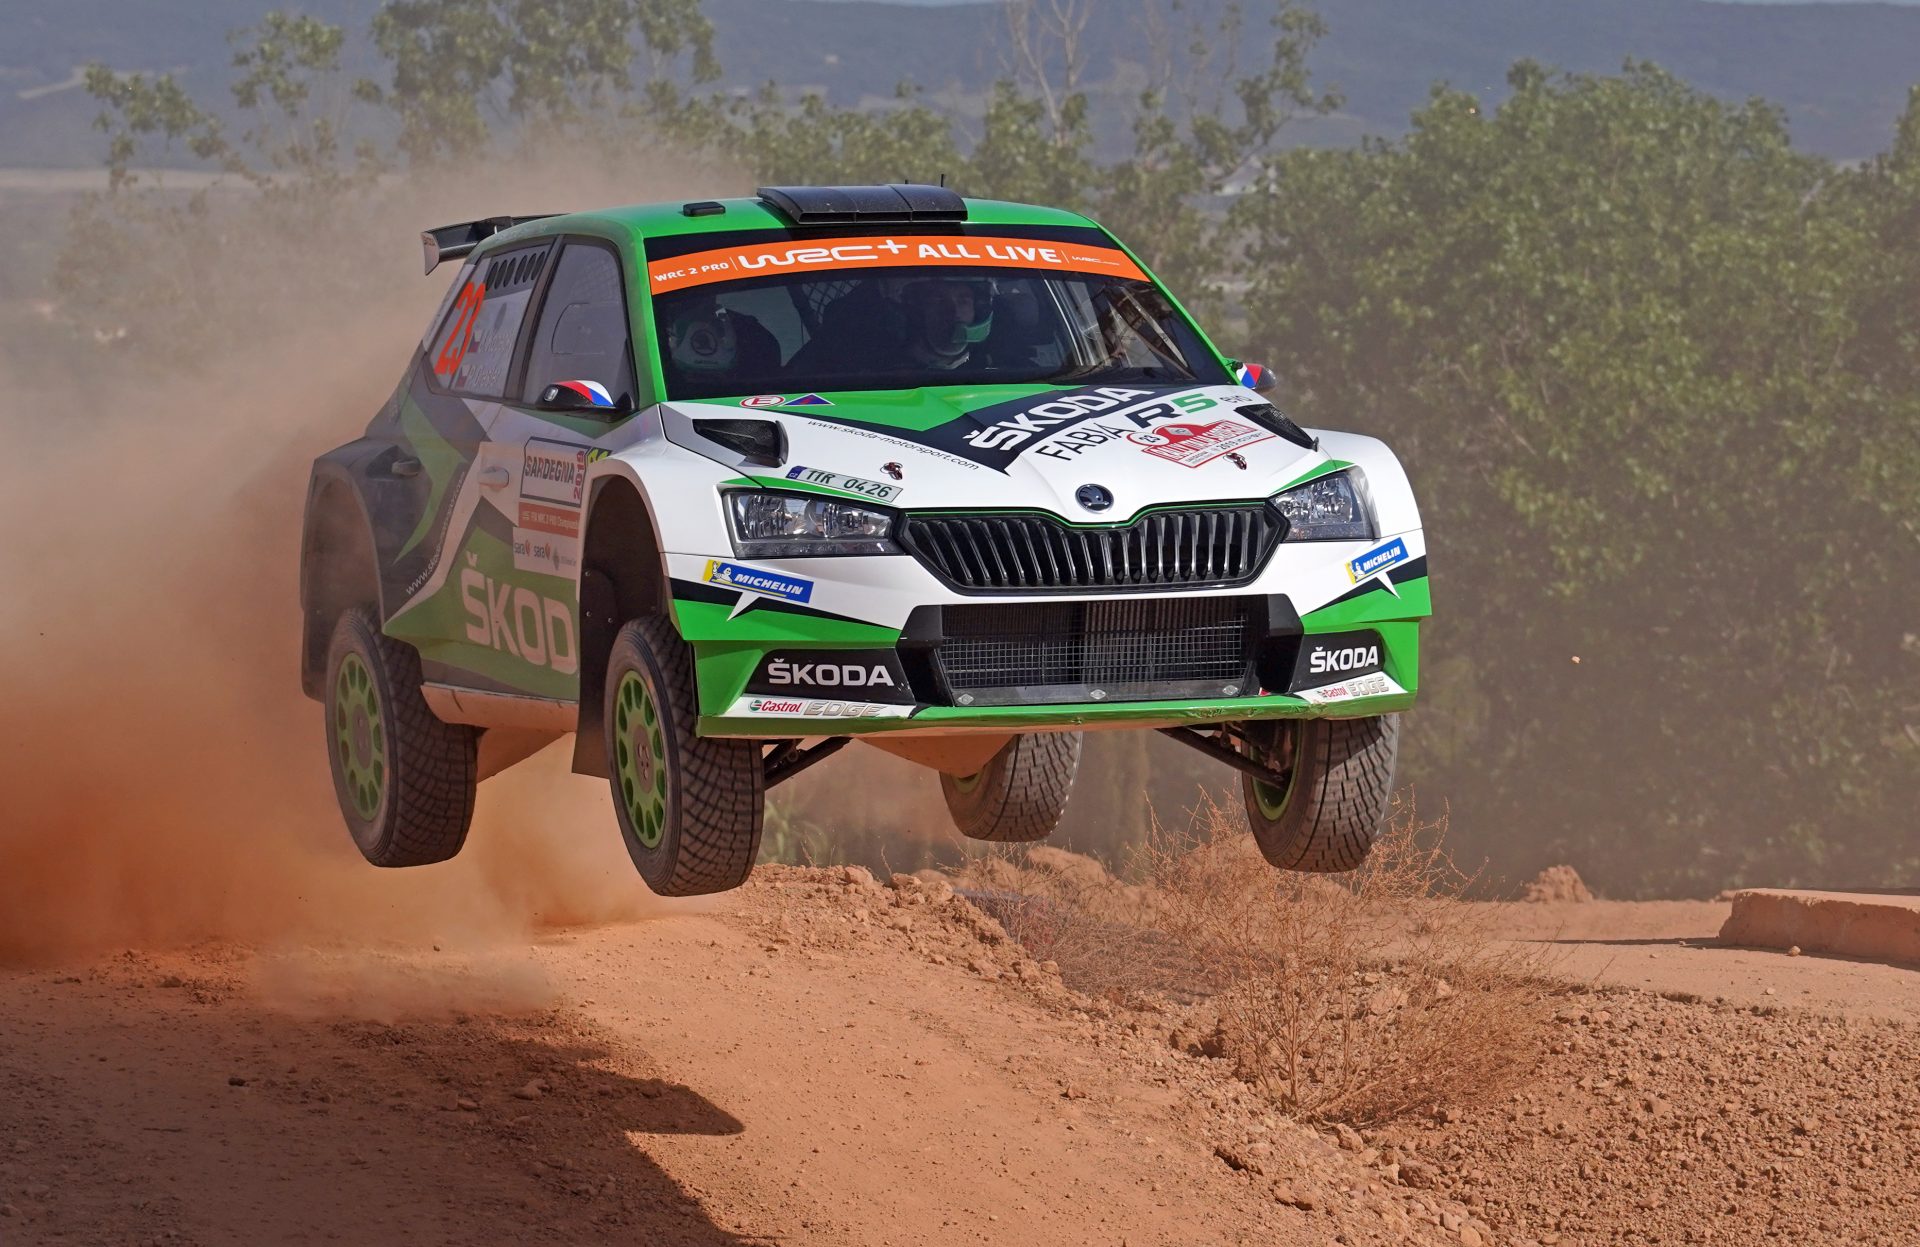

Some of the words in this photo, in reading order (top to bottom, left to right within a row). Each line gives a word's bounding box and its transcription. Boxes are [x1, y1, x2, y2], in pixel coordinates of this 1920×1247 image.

[654, 269, 686, 282] WRC
[687, 267, 698, 275] 2
[701, 262, 729, 273] PRO
[918, 243, 969, 259] ALL
[986, 244, 1062, 263] LIVE
[434, 282, 486, 375] 23
[962, 387, 1155, 451] ŠKODA
[1035, 422, 1136, 461] FABIA
[1125, 393, 1218, 429] R5
[807, 420, 979, 471] www.skoda-motorsport.com
[525, 456, 575, 484] SARDEGNA
[574, 450, 585, 499] 2019
[843, 478, 892, 498] 0426
[1363, 546, 1401, 571] MICHELIN
[734, 573, 804, 595] MICHELIN
[461, 551, 578, 675] ŠKOD
[767, 658, 895, 687] ŠKODA
[1309, 646, 1379, 673] ŠKODA
[1346, 676, 1390, 697] EDGE
[761, 700, 802, 713] Castrol
[803, 701, 886, 717] EDGE
